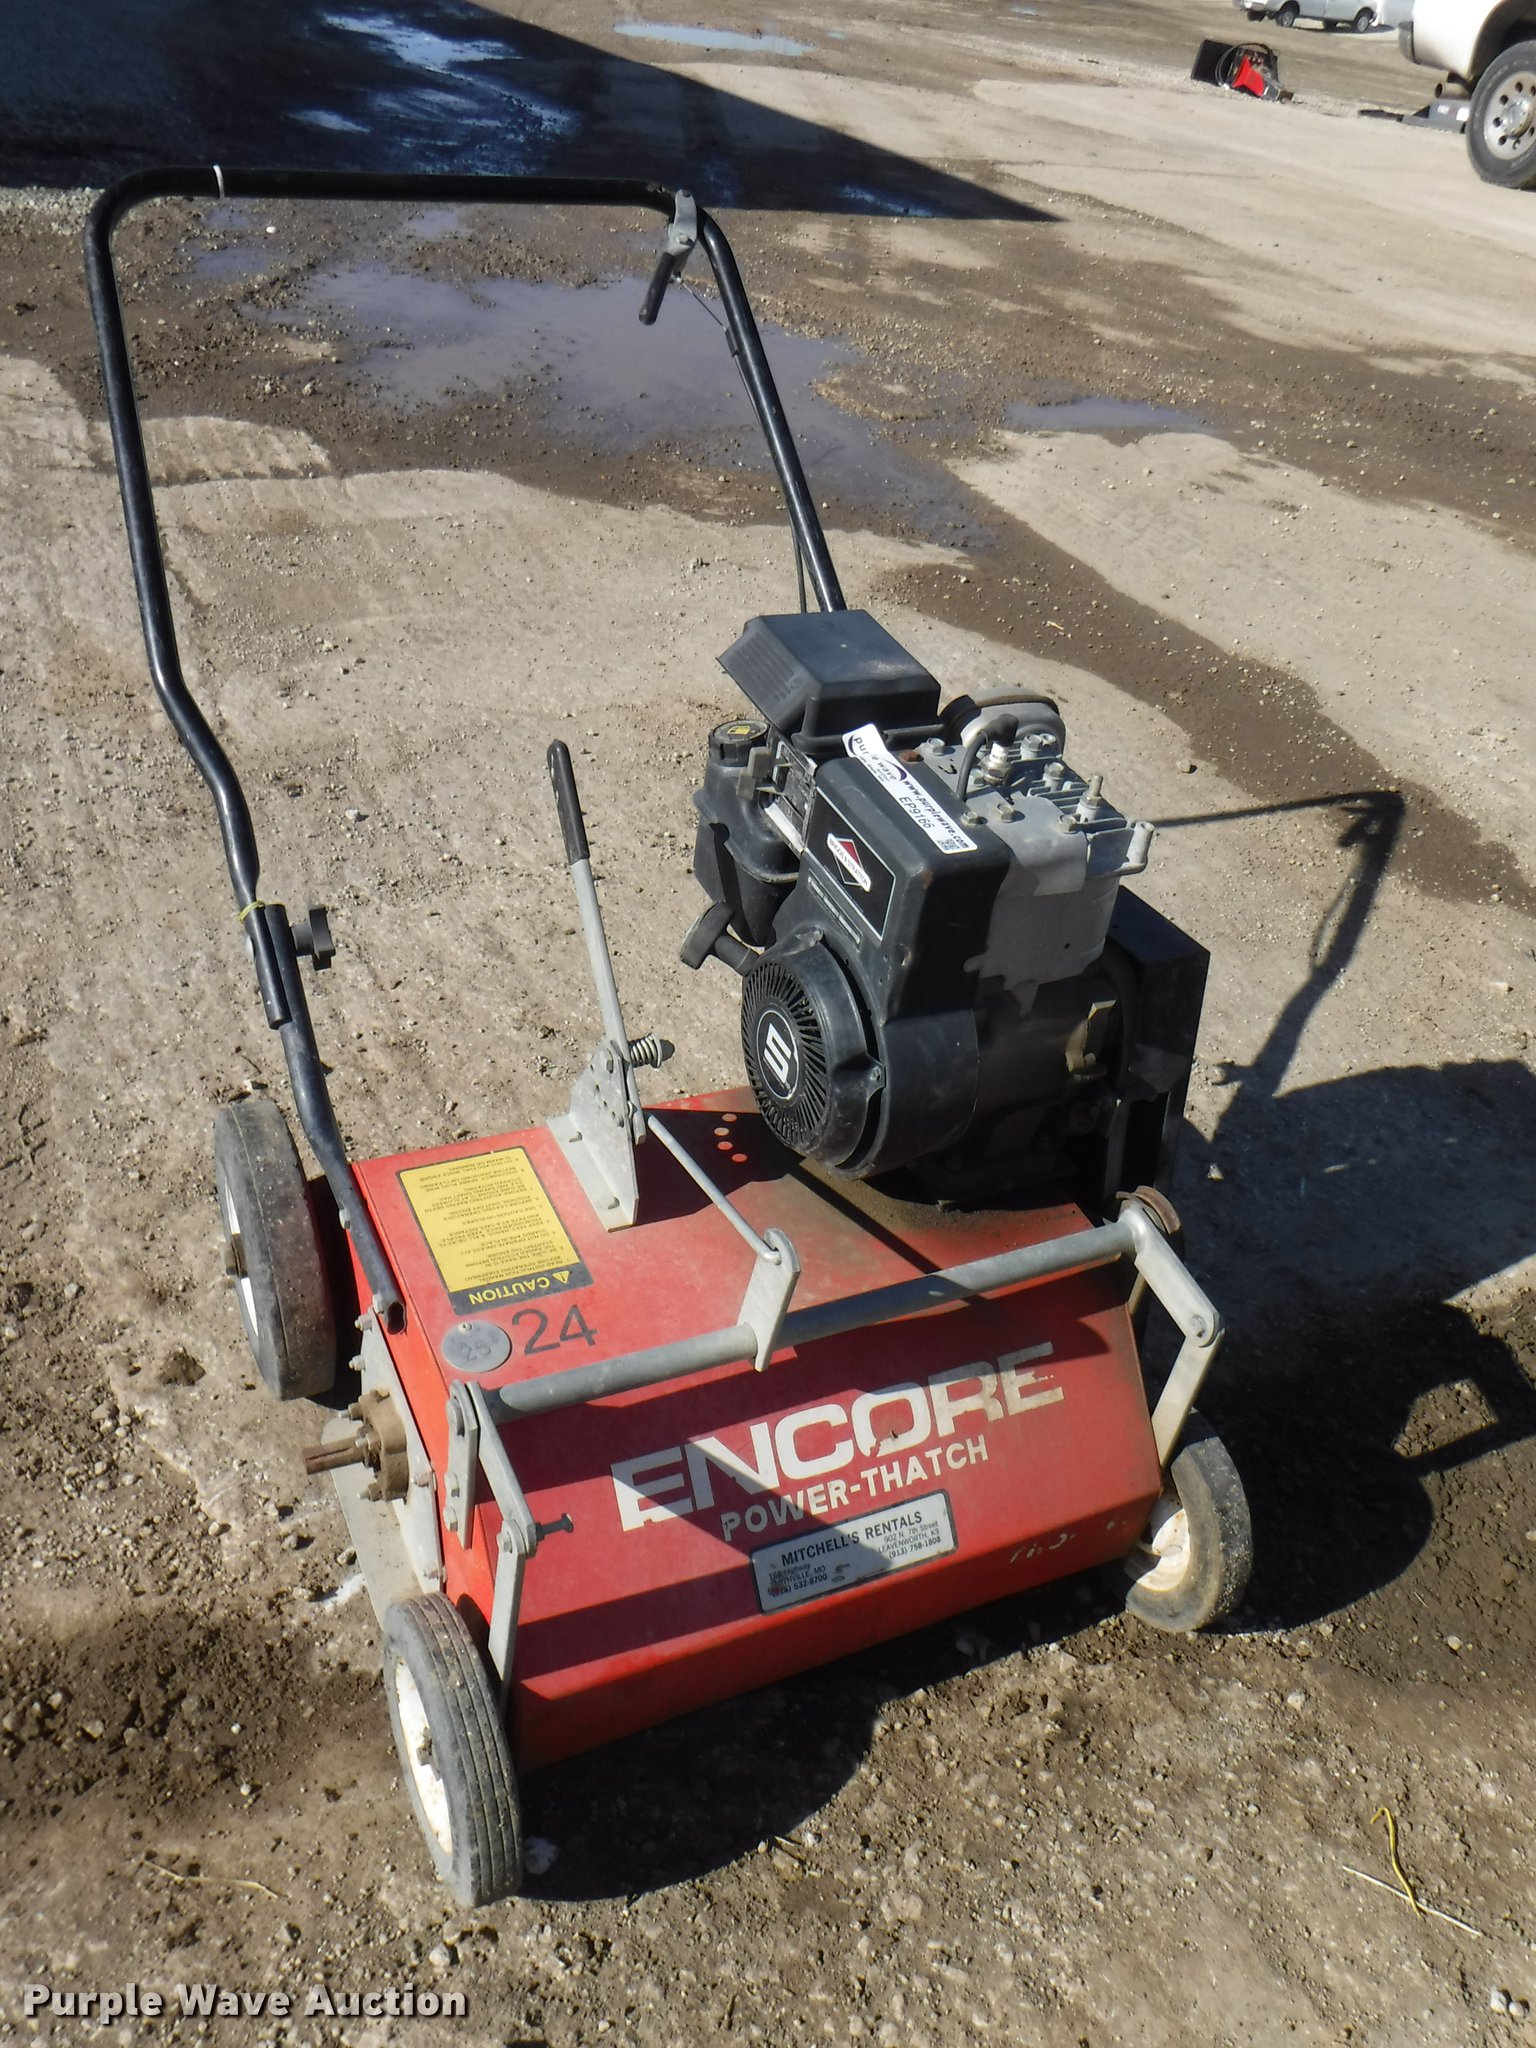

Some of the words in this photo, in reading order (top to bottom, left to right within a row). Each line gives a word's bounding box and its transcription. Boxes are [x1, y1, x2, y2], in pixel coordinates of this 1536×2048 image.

[899, 797, 935, 828] EP9166
[903, 780, 969, 849] www.purplewave.com
[469, 1277, 550, 1305] CAUTION
[512, 1305, 599, 1356] 24
[610, 1341, 1065, 1532] ENCORE
[721, 1434, 989, 1541] POWER-THATCH
[781, 1531, 860, 1566] MITCHELL'S
[865, 1511, 923, 1540] RENTALS
[919, 1519, 938, 1531] Street
[930, 1527, 939, 1536] KS
[888, 1546, 907, 1559] (913)
